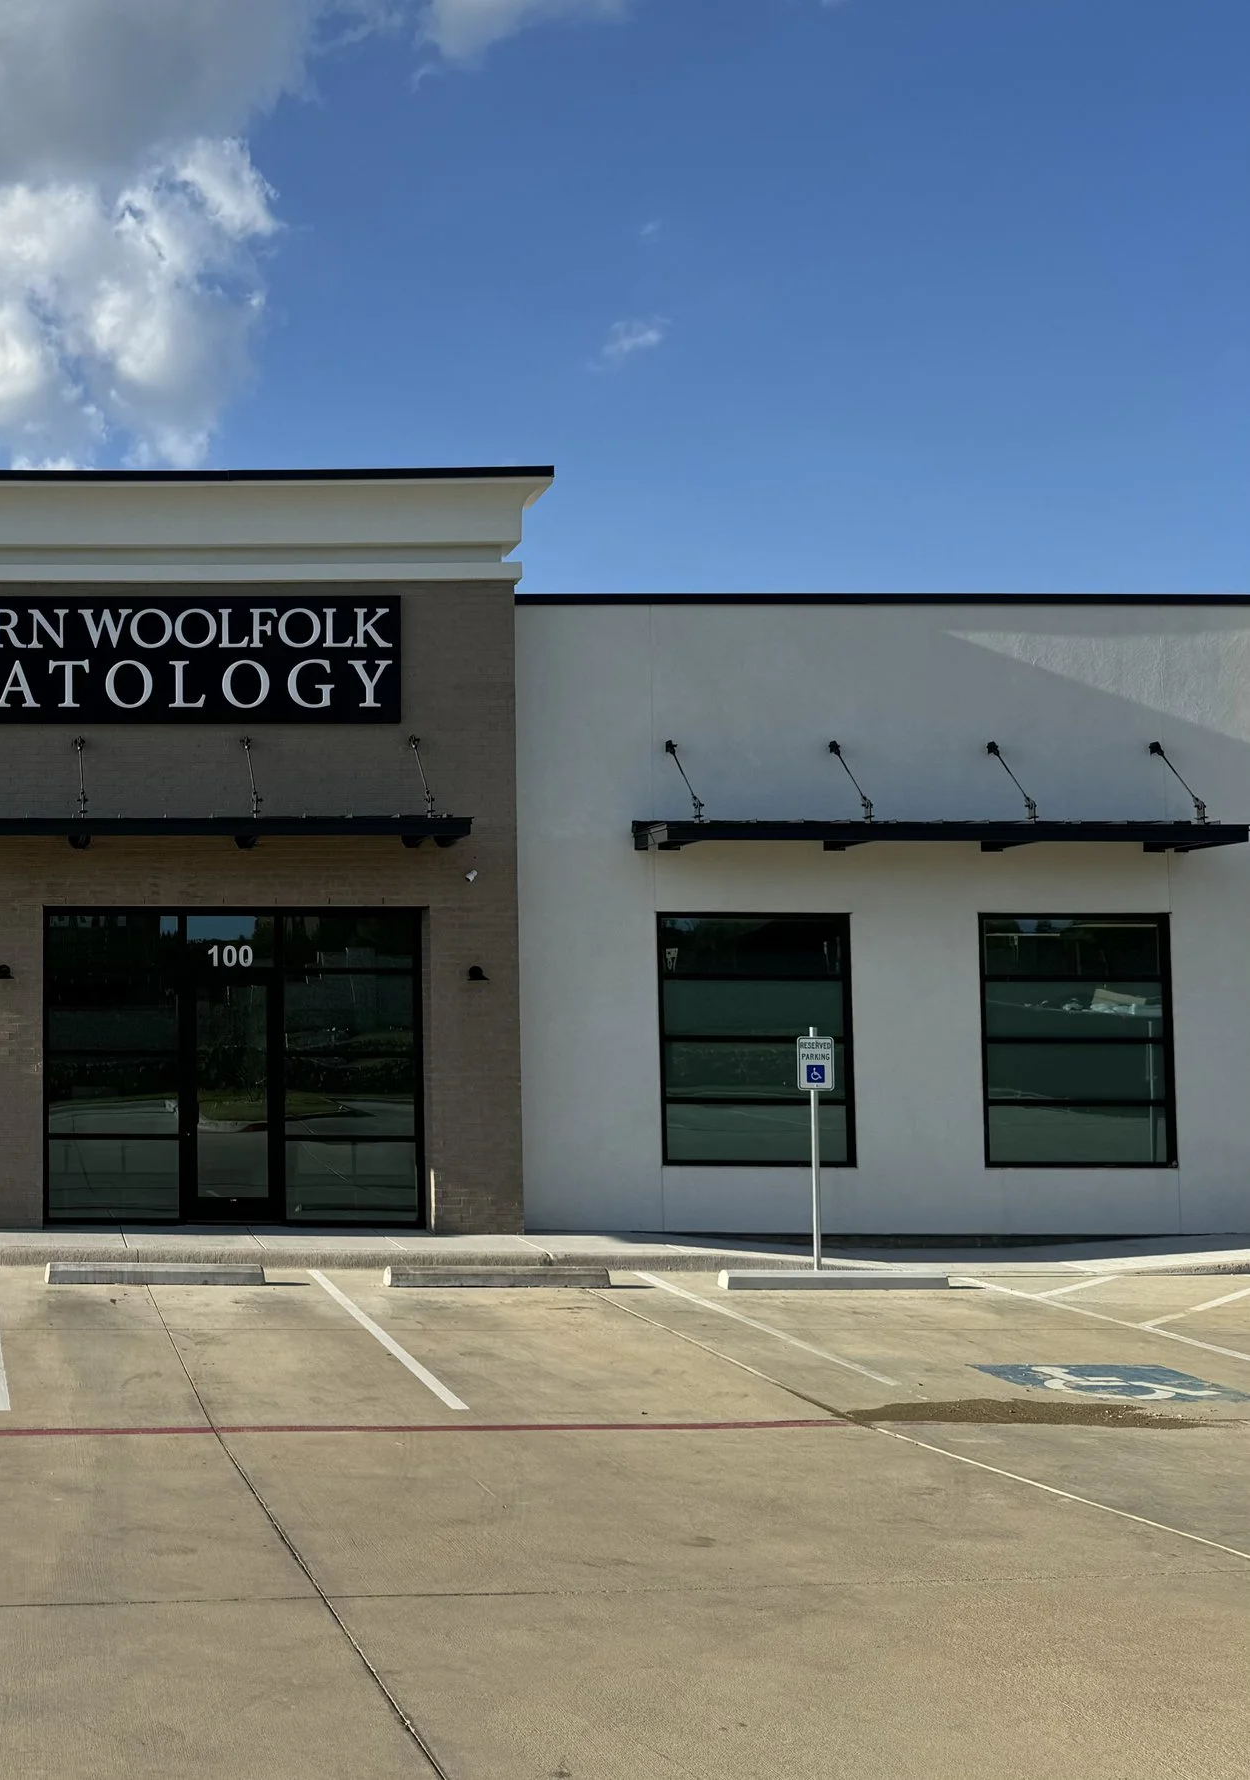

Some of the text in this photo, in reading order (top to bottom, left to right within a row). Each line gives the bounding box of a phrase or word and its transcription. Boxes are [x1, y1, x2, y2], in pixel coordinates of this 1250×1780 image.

[77, 607, 393, 649] WOOLFOLK
[207, 945, 253, 967] 100
[800, 1041, 831, 1049] RESERVED
